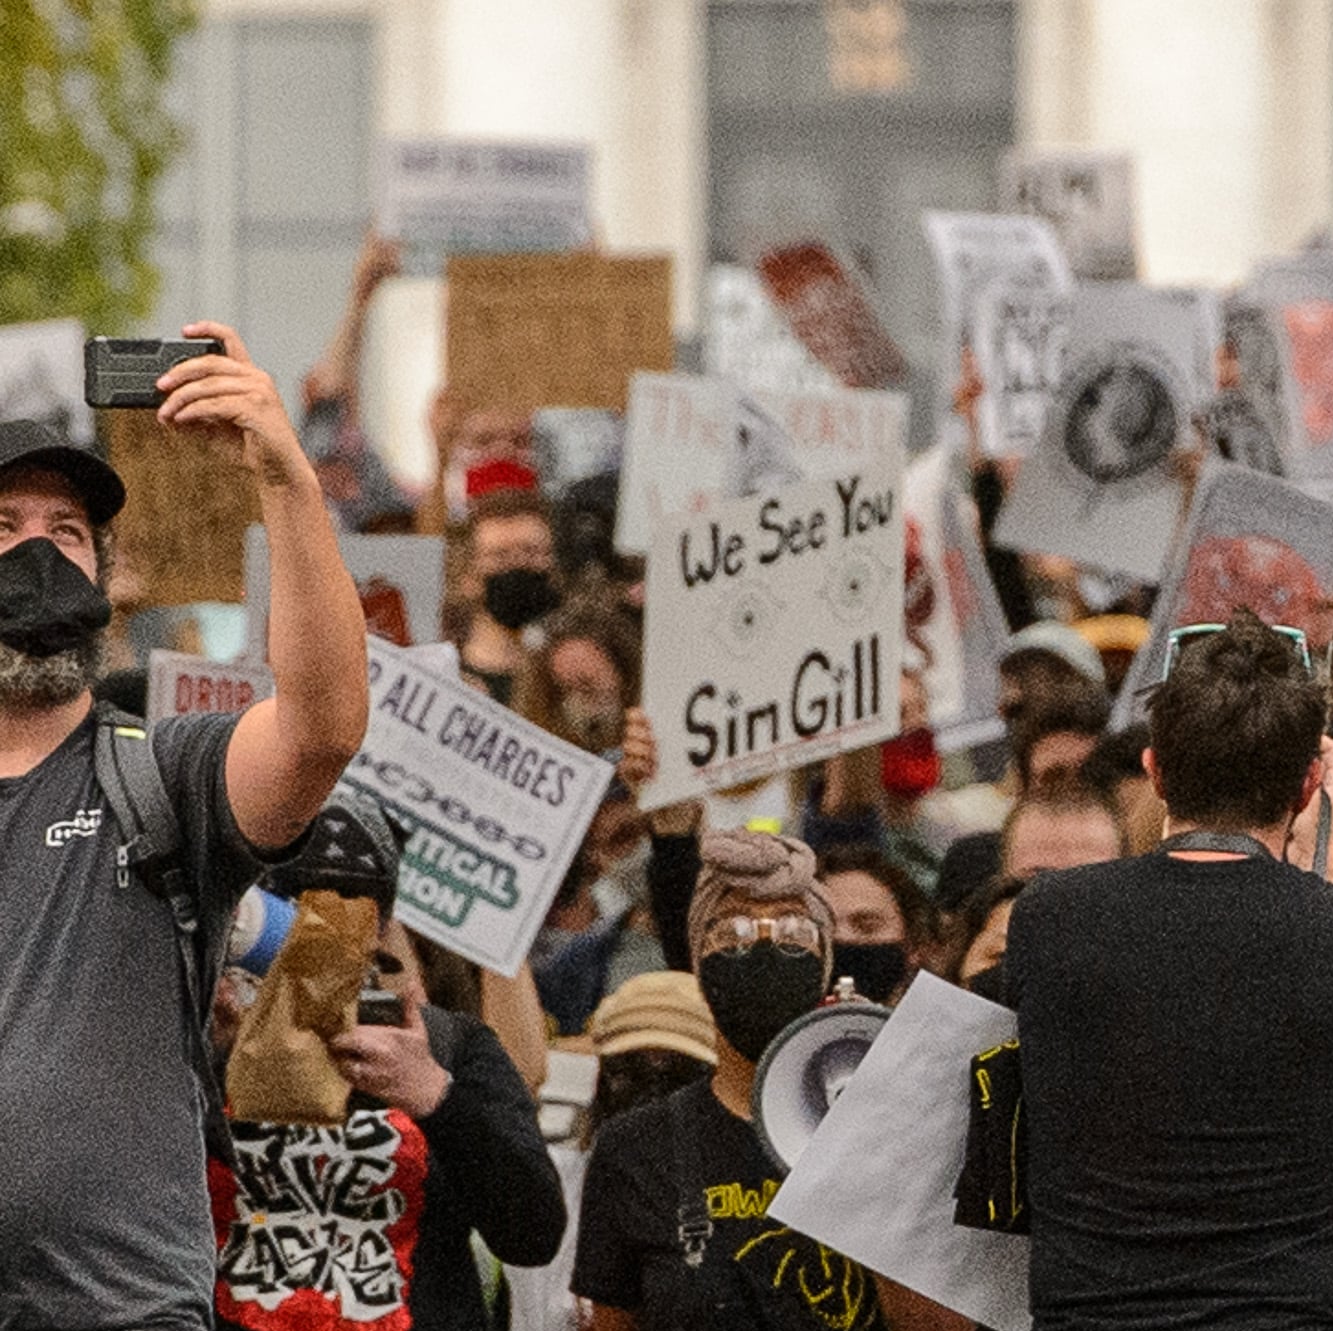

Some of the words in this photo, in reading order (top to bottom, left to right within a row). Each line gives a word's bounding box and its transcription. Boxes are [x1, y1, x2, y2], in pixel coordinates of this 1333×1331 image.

[679, 523, 746, 587] We
[759, 499, 826, 564] See
[836, 475, 894, 538] You
[378, 673, 438, 734] ALL
[438, 703, 576, 808] CHARGES
